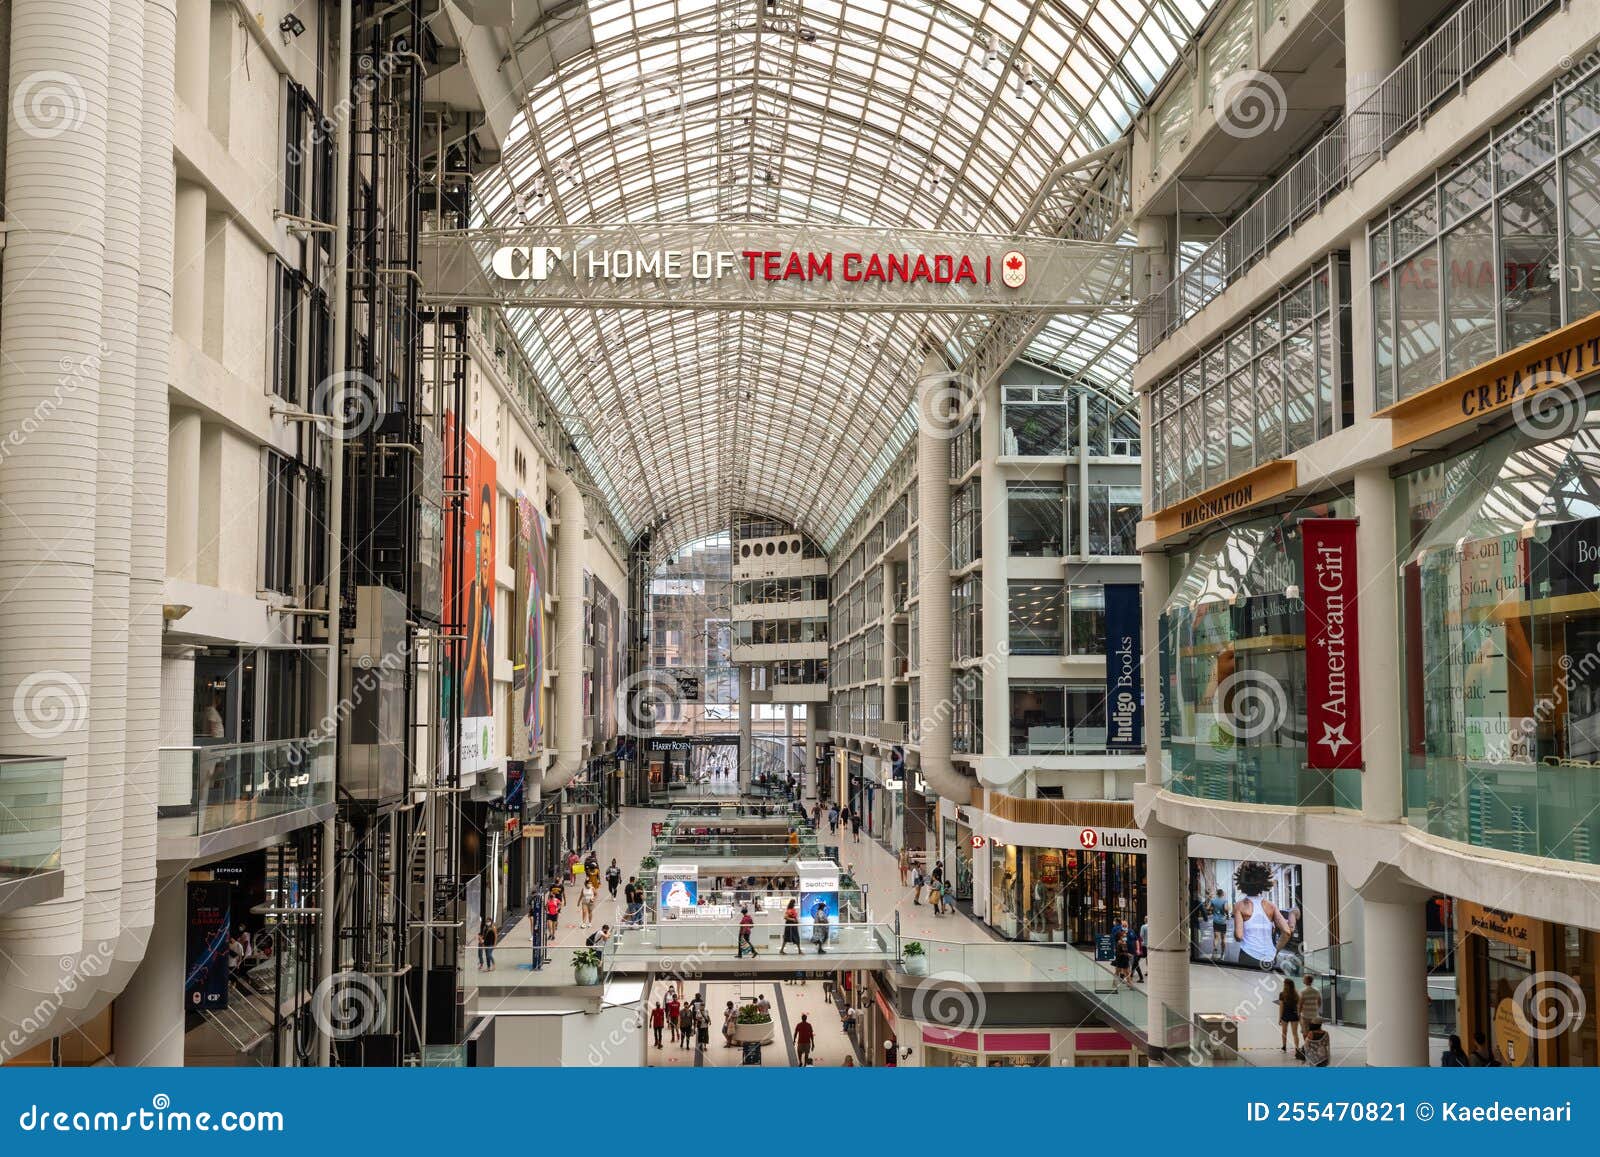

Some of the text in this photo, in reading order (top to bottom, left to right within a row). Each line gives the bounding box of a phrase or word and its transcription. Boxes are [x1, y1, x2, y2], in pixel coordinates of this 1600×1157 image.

[492, 246, 977, 284] CF HOME OF TEAM CANADA
[1180, 484, 1253, 529] IMAGINATION
[1115, 636, 1133, 687] Books
[1317, 594, 1347, 720] American
[652, 741, 691, 751] HARRY ROSEN
